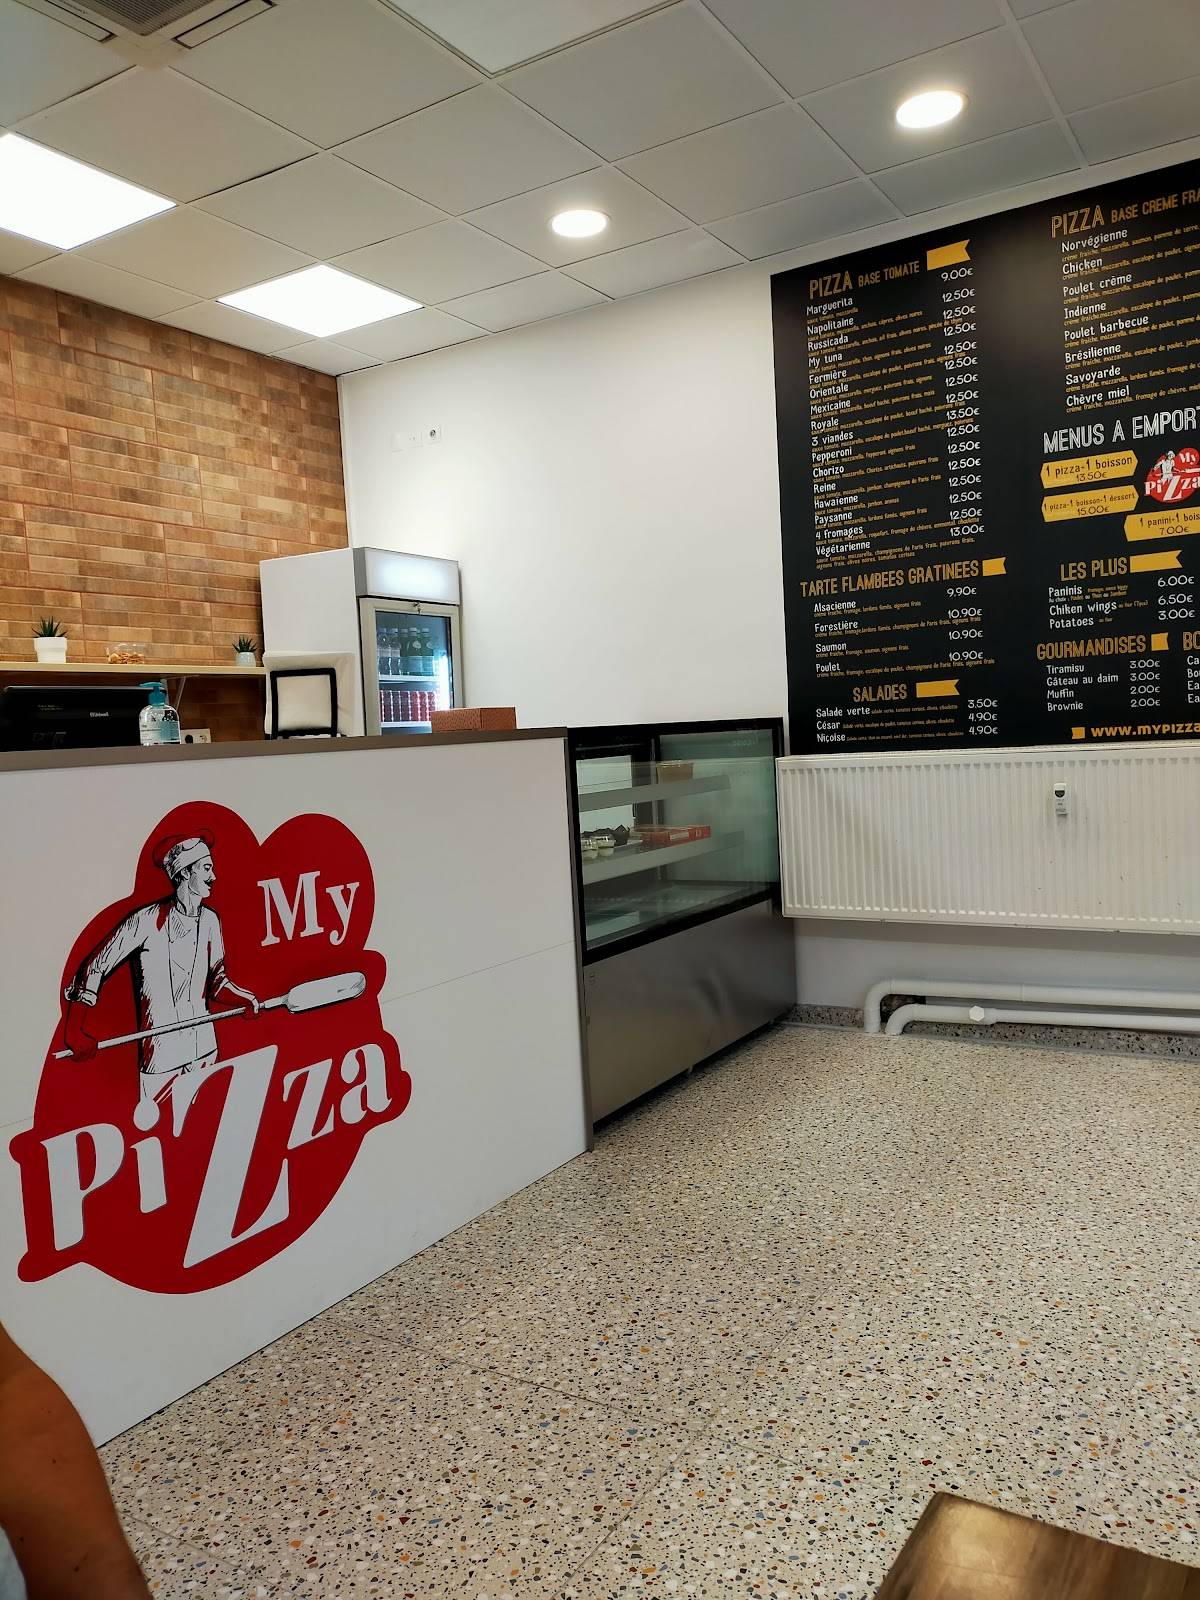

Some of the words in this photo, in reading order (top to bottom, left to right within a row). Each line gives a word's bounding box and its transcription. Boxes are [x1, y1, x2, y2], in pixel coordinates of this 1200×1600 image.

[1051, 205, 1104, 239] PIZZA
[1111, 204, 1138, 223] BASE
[1142, 194, 1178, 215] CREME
[1061, 229, 1128, 252] Norvégienne
[1062, 258, 1103, 275] Chicken
[809, 271, 853, 300] PIZZA
[858, 273, 880, 287] BASE
[884, 261, 920, 281] TOMATE
[941, 267, 973, 282] 9.00€
[1063, 282, 1095, 297] Poulet
[1100, 274, 1132, 289] crème
[942, 288, 976, 303] 12.50€
[806, 298, 853, 316] Marguerita
[943, 306, 976, 320] 12.50€
[1064, 302, 1107, 319] Indienne
[807, 318, 854, 336] Napolitaine
[944, 323, 976, 337] 12.50€
[1064, 326, 1095, 341] Poulet
[1100, 316, 1149, 334] barbecue
[808, 335, 848, 351] Russicada
[944, 342, 977, 355] 12.50€
[1065, 343, 1121, 363] Brésilienne
[808, 357, 821, 369] My
[824, 353, 843, 364] tuna
[945, 357, 978, 370] 12.50€
[809, 369, 847, 384] Fermière
[945, 374, 978, 387] 12.50€
[1066, 365, 1121, 385] Savoyarde
[810, 384, 848, 399] Orientale
[946, 390, 979, 404] 12.50€
[1066, 392, 1103, 407] Chèvre
[1108, 385, 1130, 399] miel
[810, 400, 851, 415] Mexicaine
[947, 407, 980, 421] 13.50€
[811, 418, 839, 432] Royale
[947, 424, 980, 437] 12.50€
[812, 437, 819, 446] 3
[822, 431, 853, 445] viandes
[1043, 423, 1105, 454] MENUS
[1112, 420, 1126, 443] A
[948, 441, 981, 454] 12.50€
[812, 447, 852, 464] Pepperoni
[948, 458, 981, 471] 12.50€
[1096, 456, 1133, 469] boisson
[813, 465, 844, 478] Chorizo
[1076, 471, 1107, 482] 13.50€
[949, 475, 982, 487] 12.50€
[814, 482, 836, 494] Reine
[815, 495, 858, 509] Hawaïenne
[949, 491, 982, 504] 12.50€
[950, 508, 983, 520] 12.50€
[1077, 505, 1109, 516] 15.00€
[815, 512, 853, 526] Paysanne
[816, 532, 821, 540] 4
[824, 526, 864, 540] fromages
[950, 524, 985, 537] 13.00€
[1160, 525, 1189, 536] 7.00€
[816, 541, 870, 558] Végétarienne
[1061, 562, 1086, 582] LES
[1092, 557, 1127, 578] PLUS
[800, 579, 838, 597] TARTE
[842, 569, 904, 592] FLAMBEES
[909, 560, 979, 585] GRATINEES
[1158, 575, 1195, 587] 6.00€
[947, 586, 977, 597] 9.90€
[1049, 585, 1082, 597] Paninis
[1158, 594, 1193, 605] 6.50€
[814, 601, 856, 613] Alsacienne
[948, 608, 983, 619] 10.90€
[1050, 603, 1082, 616] Chiken
[1087, 601, 1117, 614] wings
[1158, 609, 1195, 620] 3.00€
[815, 620, 858, 633] Forestière
[1049, 617, 1094, 629] Potatoes
[949, 629, 983, 641] 10.90€
[816, 643, 847, 653] Saumon
[1037, 635, 1146, 660] GOURMANDISES
[949, 650, 984, 662] 10.90€
[816, 663, 840, 673] Poulet
[1046, 664, 1085, 674] Tiramisu
[1130, 659, 1160, 669] 3.00€
[1047, 676, 1078, 686] Gâteau
[1097, 674, 1118, 683] daim
[1130, 672, 1160, 681] 3.00€
[853, 684, 908, 703] SALADES
[1047, 689, 1074, 699] Muffin
[1130, 685, 1160, 694] 2.00€
[967, 699, 998, 709] 3.50€
[1047, 701, 1083, 712] Brownie
[1130, 698, 1160, 707] 2.00€
[816, 708, 843, 718] Salade
[847, 706, 871, 716] verte
[968, 712, 998, 722] 4.90€
[817, 721, 840, 730] César
[968, 726, 998, 736] 4.90€
[817, 733, 846, 744] Niçoise
[256, 869, 362, 949] My
